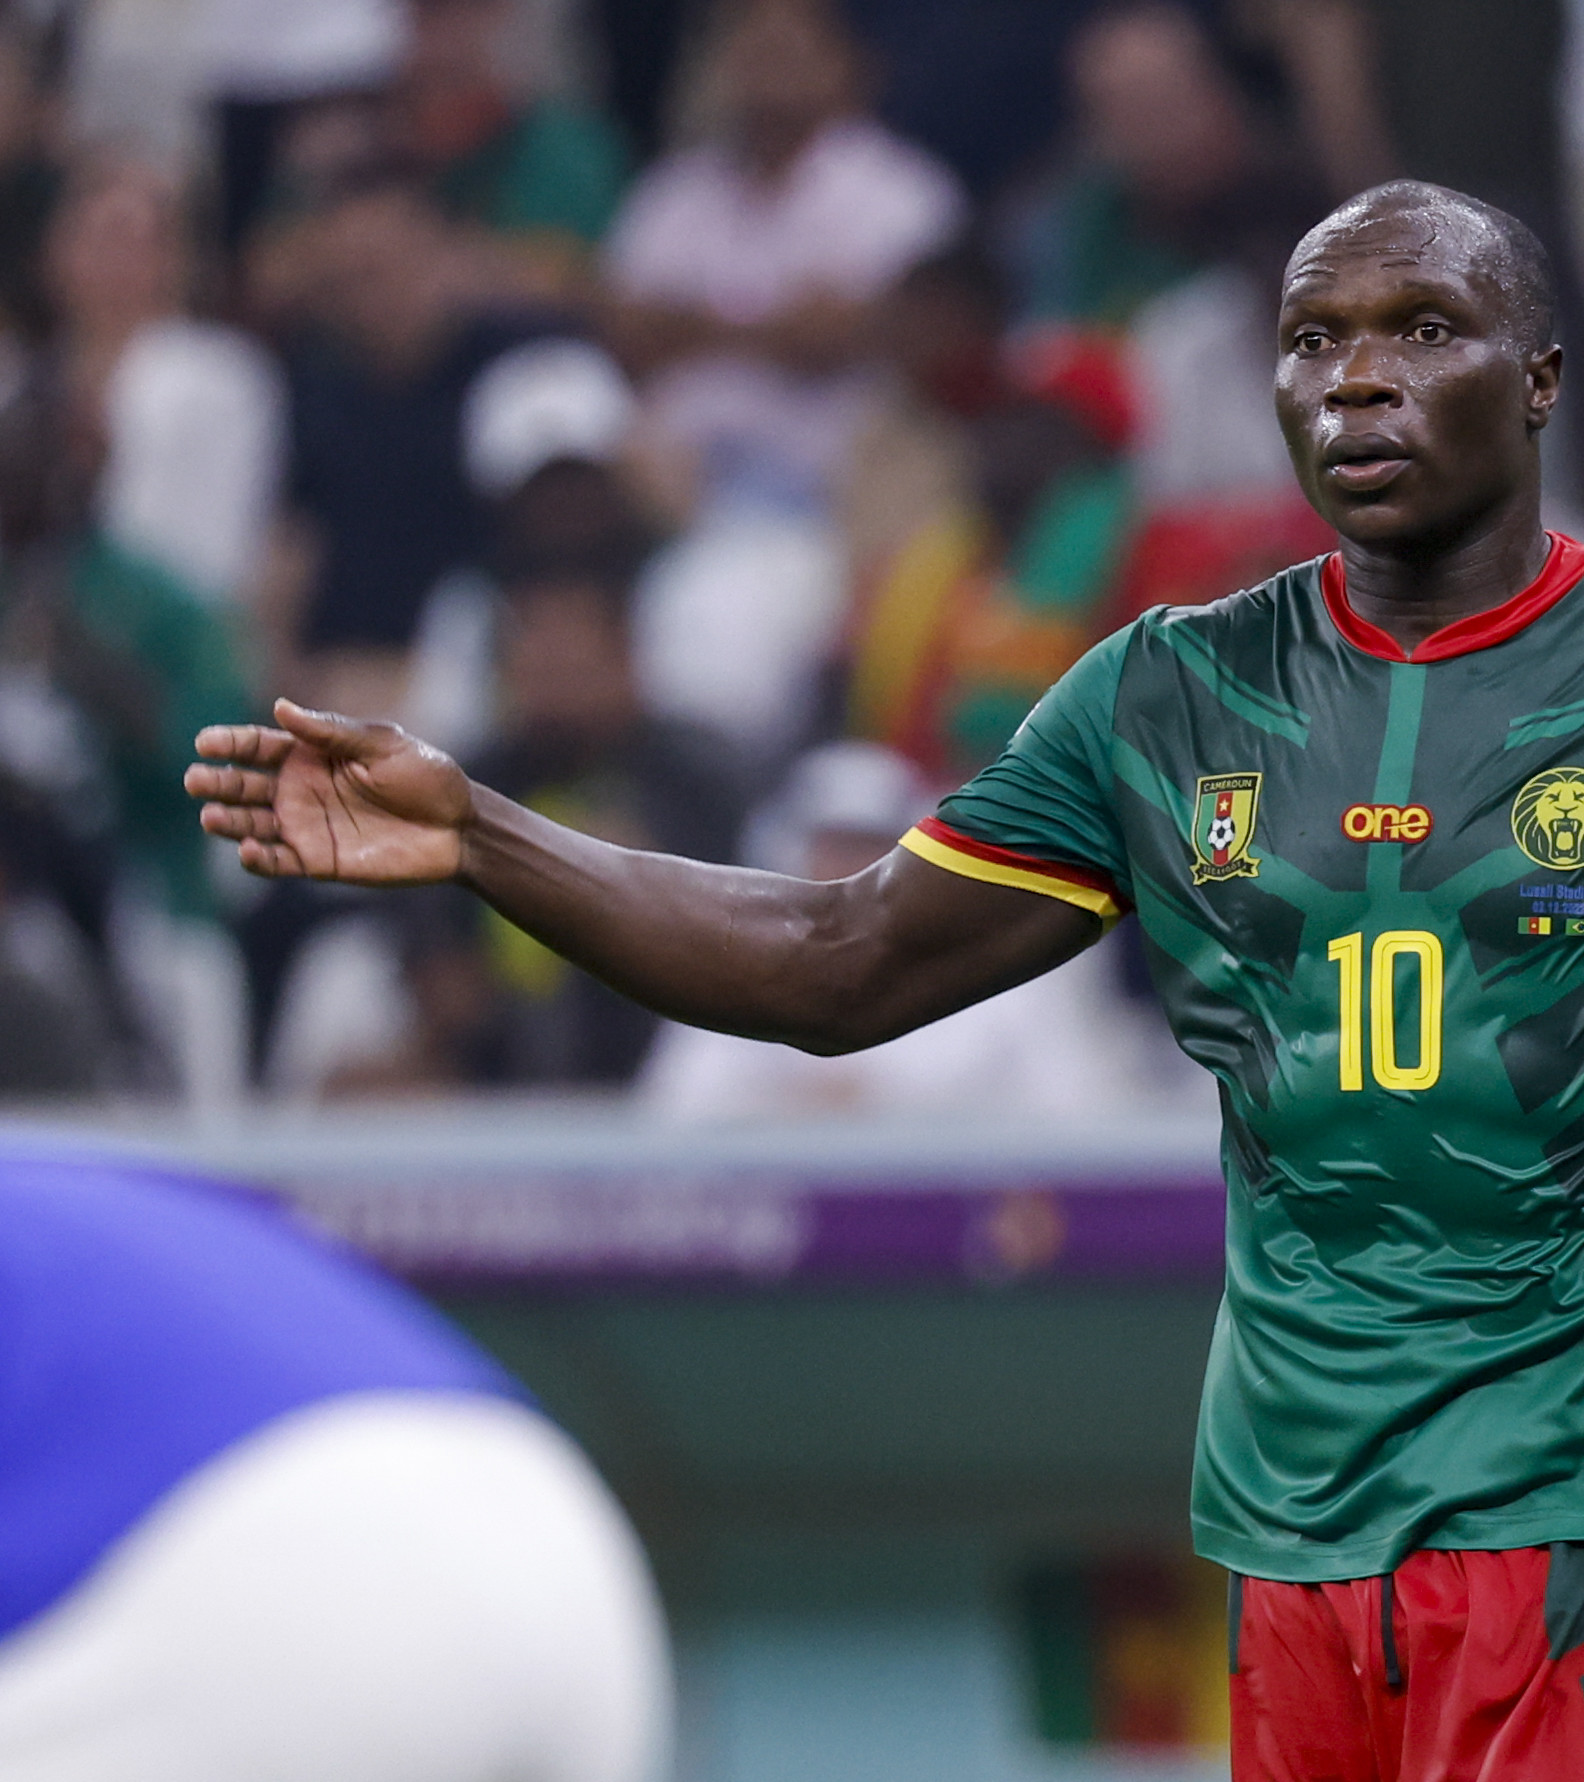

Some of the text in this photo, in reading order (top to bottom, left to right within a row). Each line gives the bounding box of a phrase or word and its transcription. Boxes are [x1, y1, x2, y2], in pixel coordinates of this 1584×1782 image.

[1203, 779, 1252, 792] CAMEROUN
[1344, 806, 1430, 839] one
[1327, 929, 1444, 1092] 10
